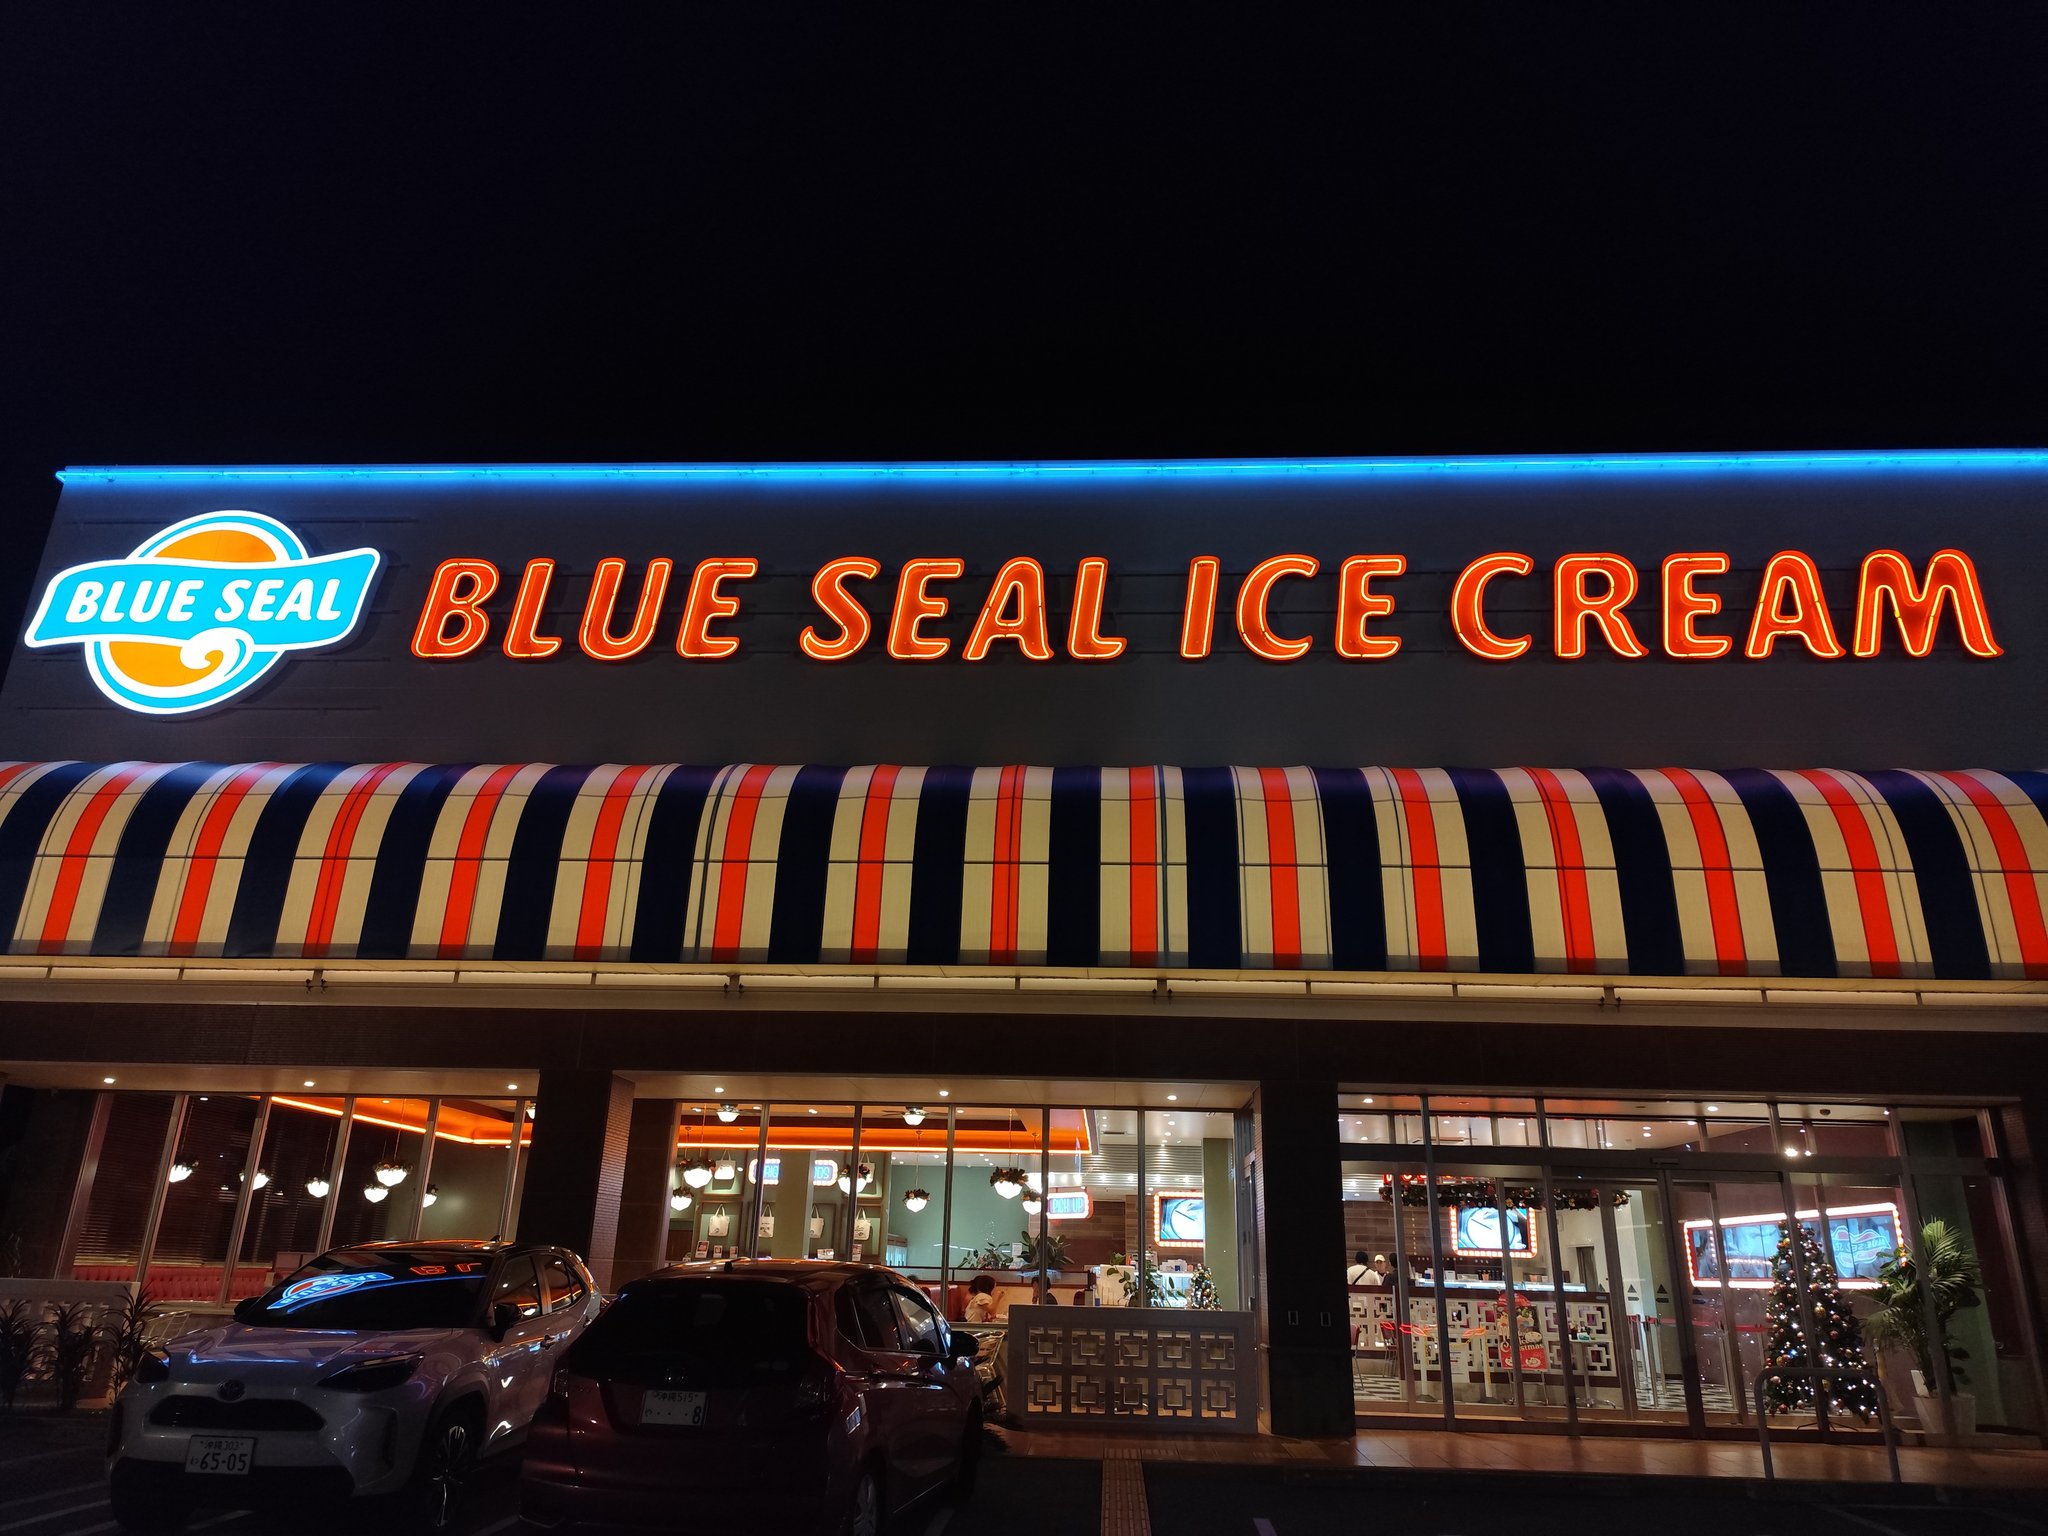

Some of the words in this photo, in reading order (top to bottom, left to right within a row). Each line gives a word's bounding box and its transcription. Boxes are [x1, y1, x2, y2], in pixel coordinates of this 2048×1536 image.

[66, 581, 204, 623] BLUE
[214, 579, 342, 622] SEAL
[411, 557, 759, 660] BLUE
[799, 556, 1128, 661] SEAL
[1180, 554, 1407, 661] ICE
[1450, 549, 2005, 660] CREAM
[1072, 1197, 1083, 1213] UP
[200, 1452, 249, 1471] 65-05
